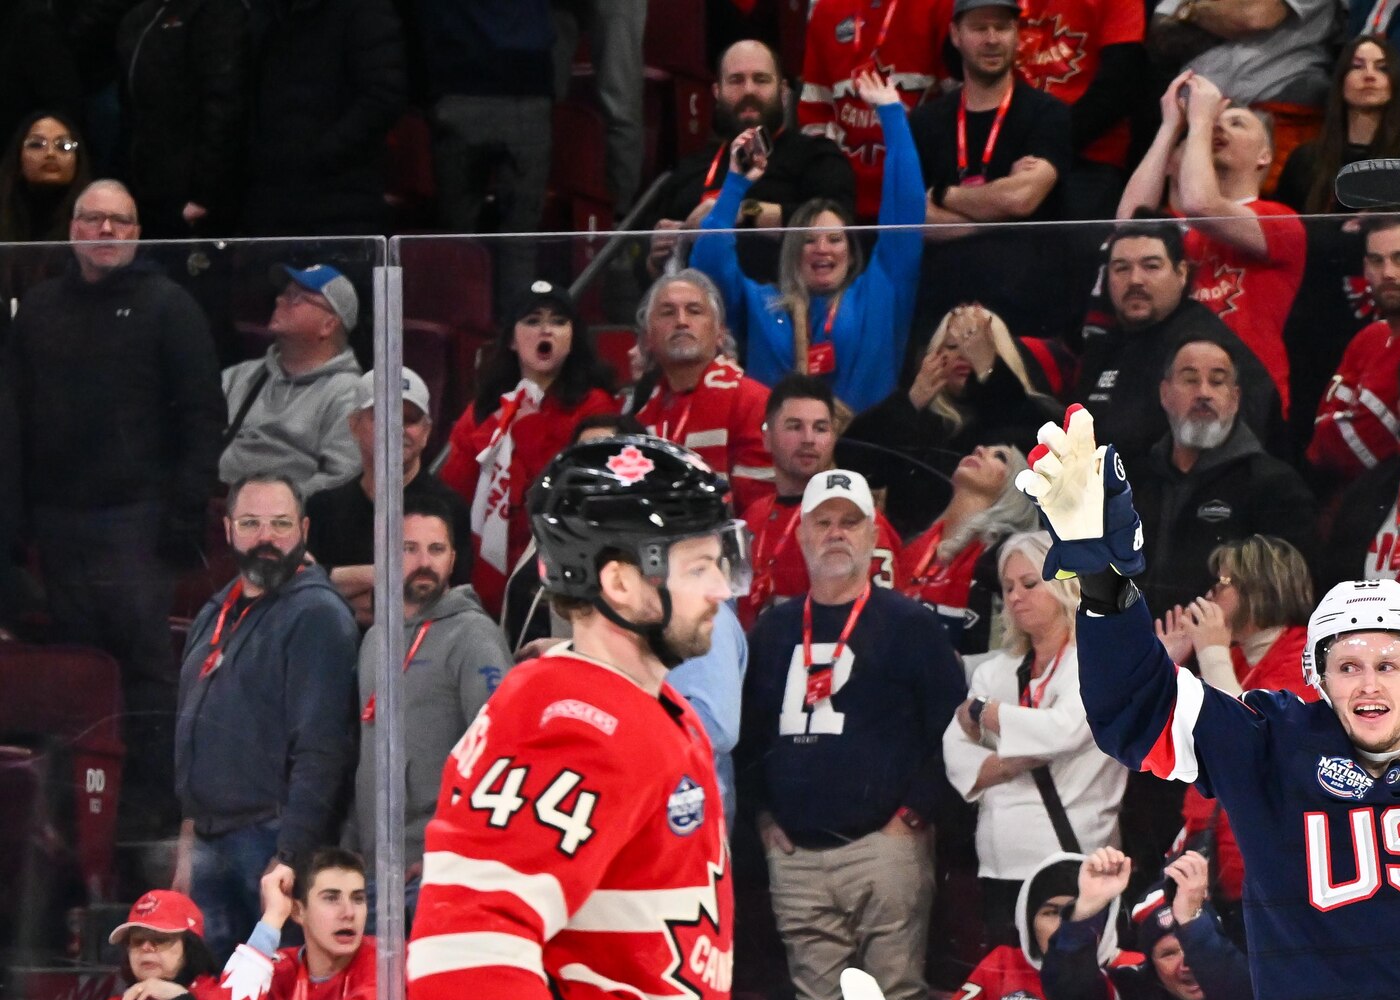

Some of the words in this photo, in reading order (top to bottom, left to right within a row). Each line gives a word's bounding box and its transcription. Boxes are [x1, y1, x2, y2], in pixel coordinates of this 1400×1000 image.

[1346, 596, 1387, 605] WARRIOR
[1318, 755, 1375, 788] NATIONS
[469, 755, 602, 858] 44
